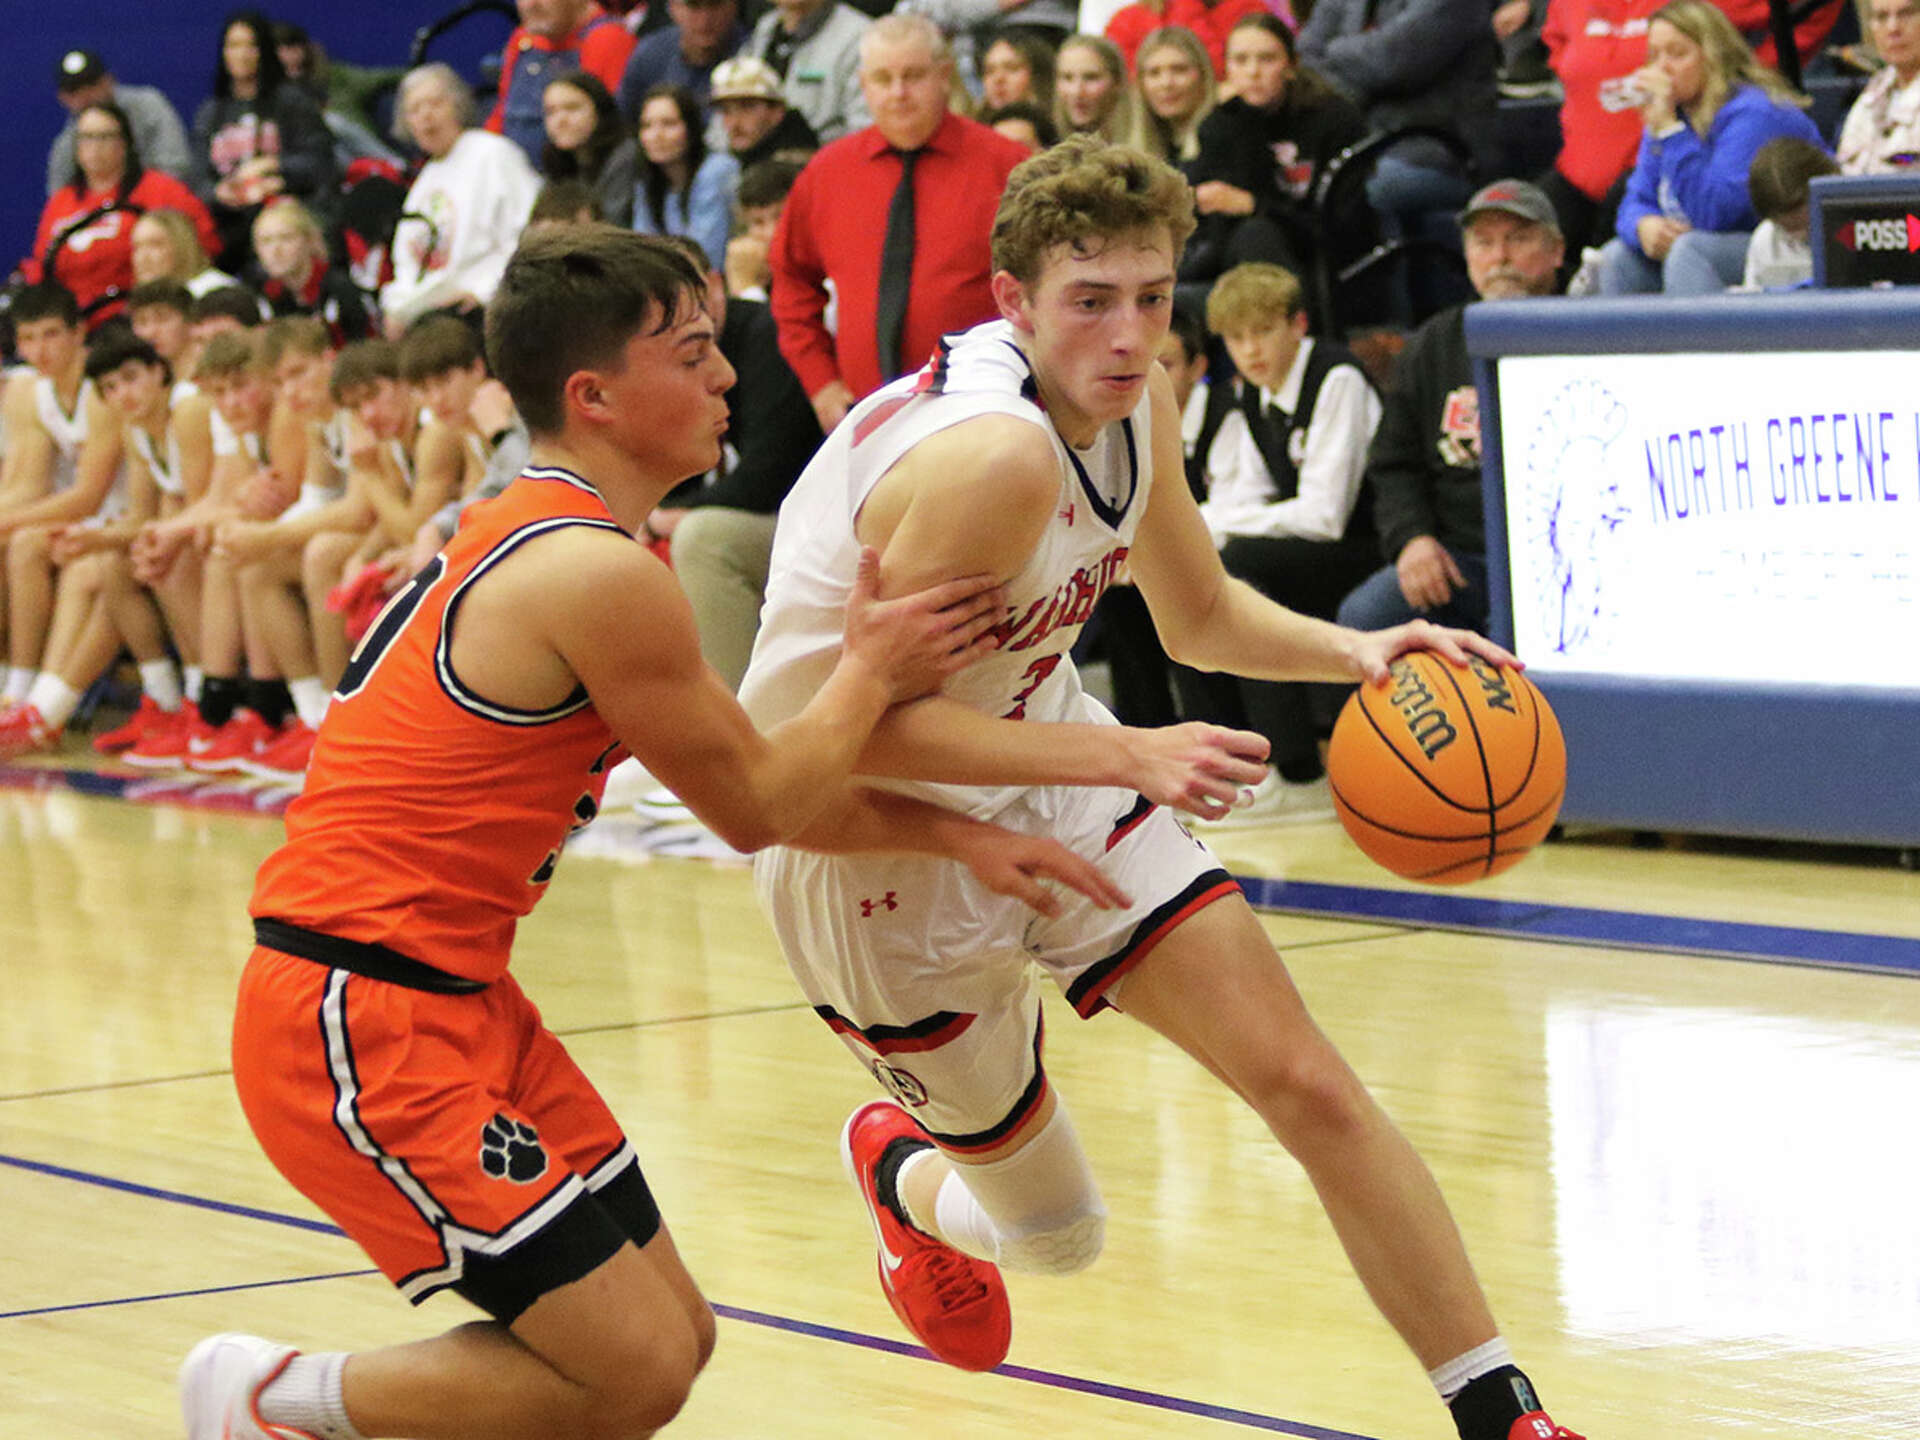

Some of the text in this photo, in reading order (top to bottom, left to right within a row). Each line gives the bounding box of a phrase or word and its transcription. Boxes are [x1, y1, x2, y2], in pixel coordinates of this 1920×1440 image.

[1855, 219, 1908, 251] POSS
[1645, 421, 1754, 525] NORTH
[1767, 412, 1899, 506] GREENE
